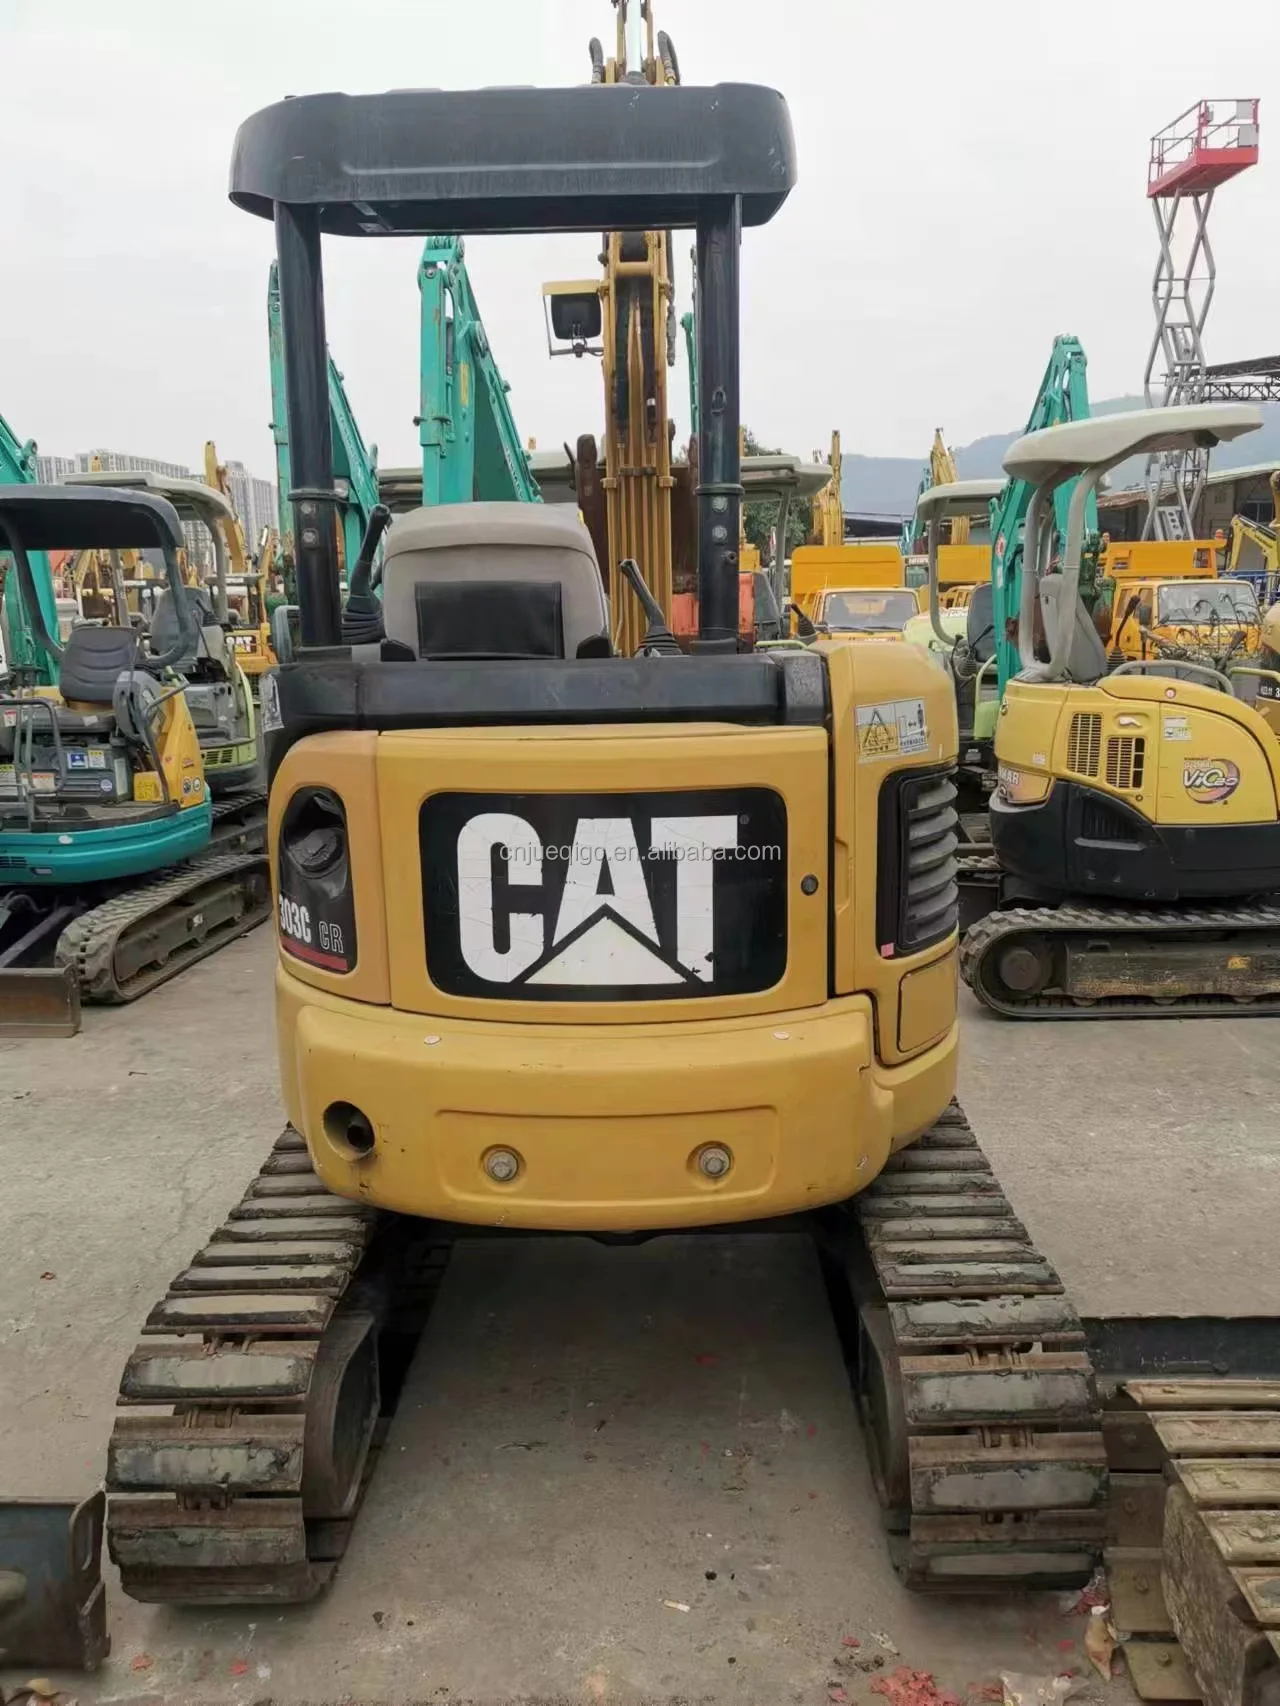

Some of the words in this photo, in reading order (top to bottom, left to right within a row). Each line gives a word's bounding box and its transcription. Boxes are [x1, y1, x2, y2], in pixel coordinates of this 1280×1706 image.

[279, 893, 312, 943] 303C
[318, 920, 345, 954] CR
[457, 812, 738, 984] CAT
